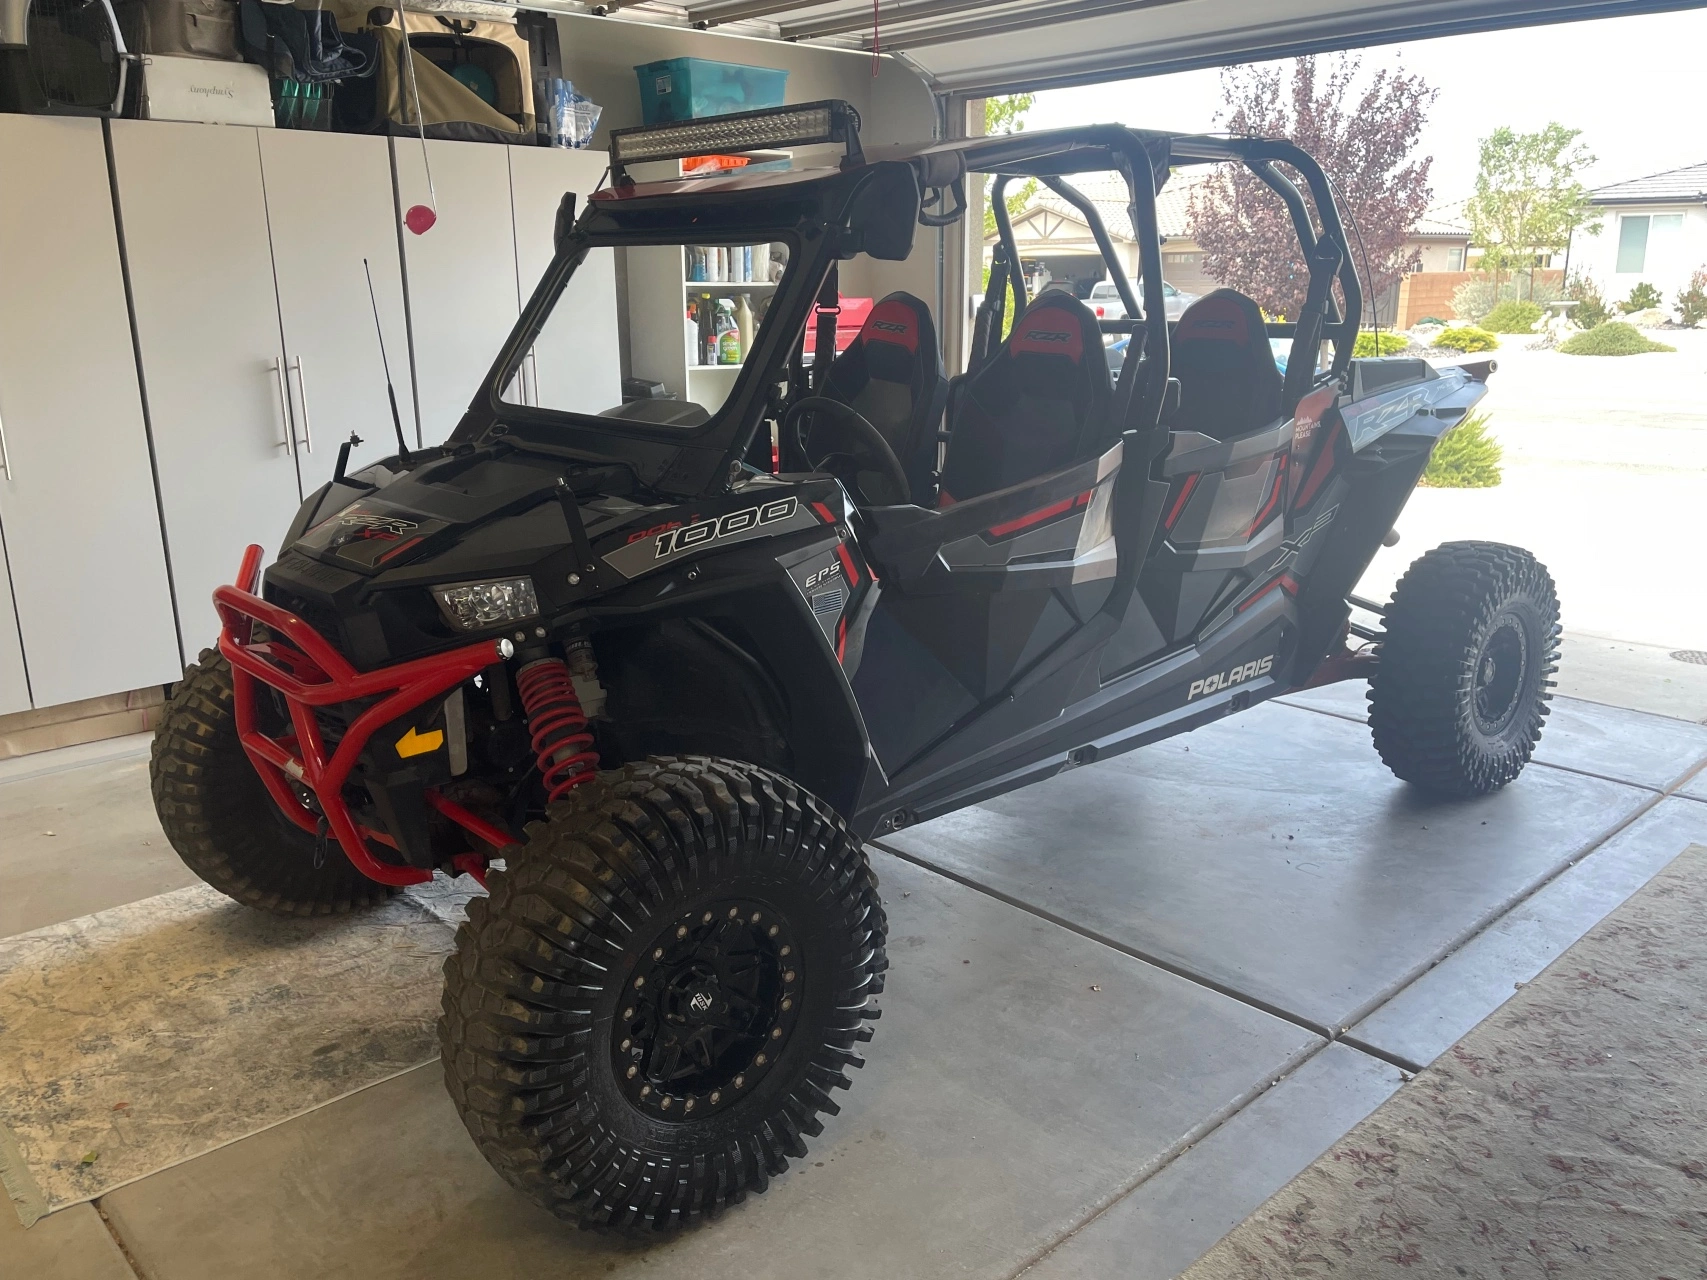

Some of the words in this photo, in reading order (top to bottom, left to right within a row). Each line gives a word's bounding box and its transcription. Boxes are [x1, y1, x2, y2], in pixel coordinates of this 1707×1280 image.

[189, 84, 235, 99] Symphony
[871, 319, 908, 335] RZR
[1353, 387, 1432, 446] RZR
[654, 496, 799, 560] 1000
[805, 560, 841, 588] EPS
[1187, 654, 1275, 701] POLARIS
